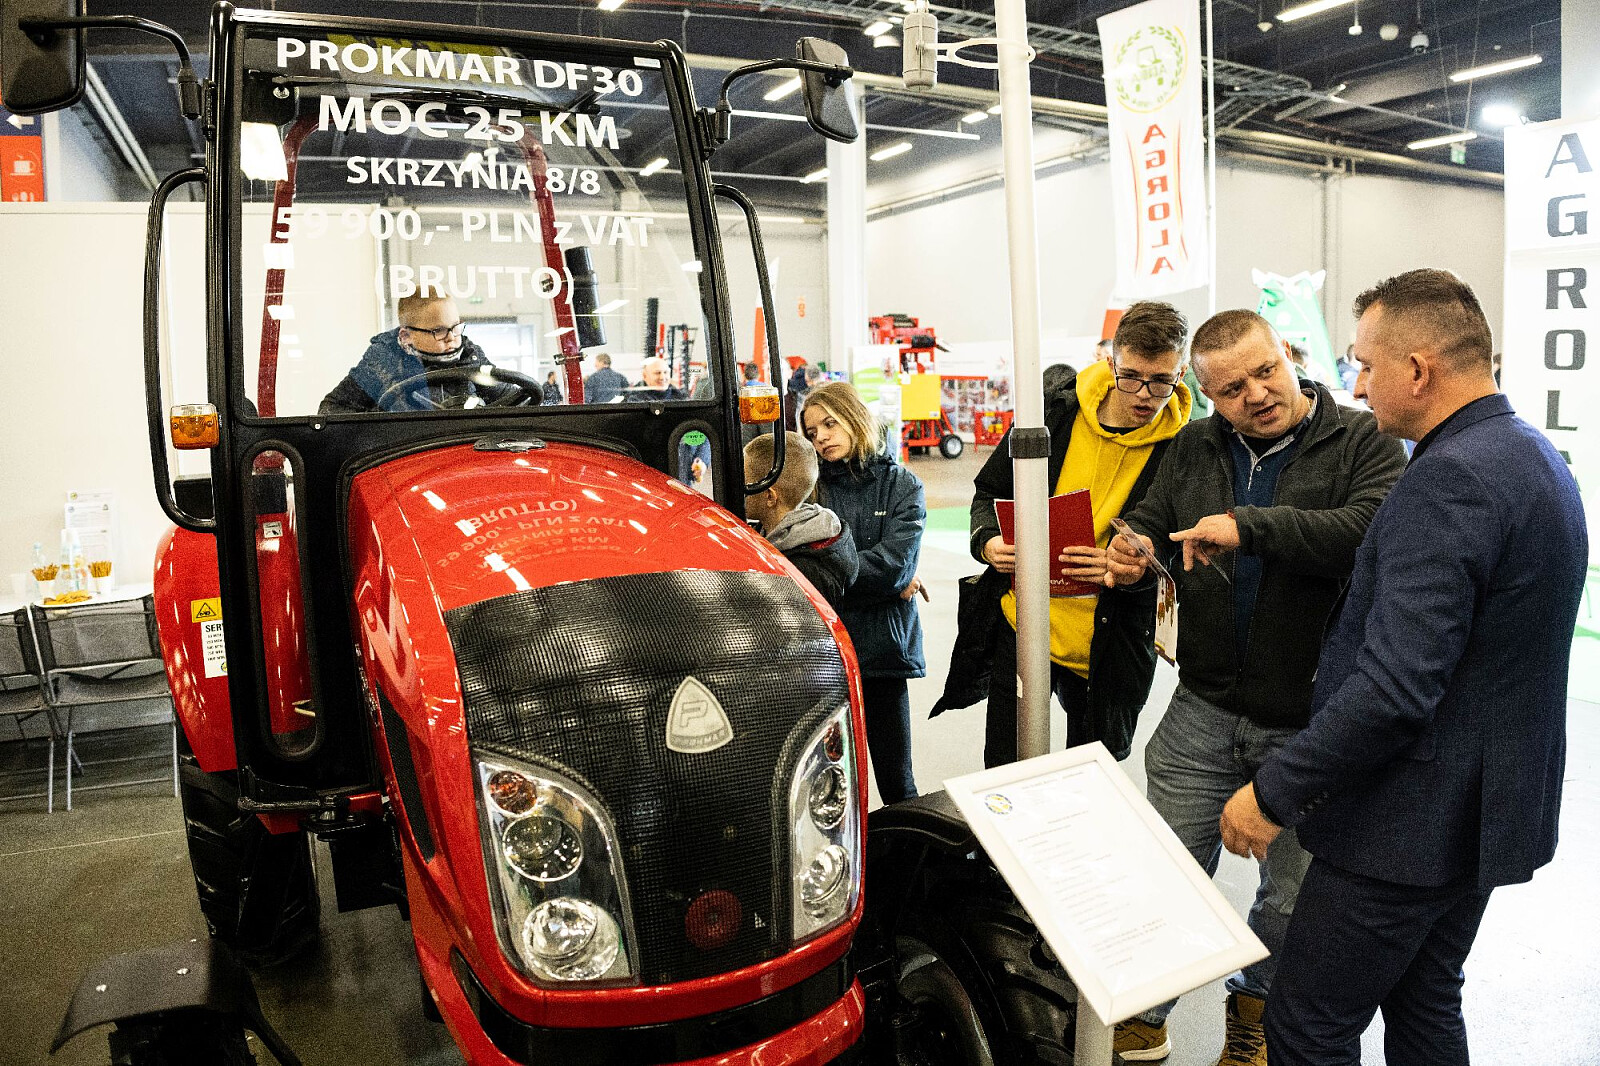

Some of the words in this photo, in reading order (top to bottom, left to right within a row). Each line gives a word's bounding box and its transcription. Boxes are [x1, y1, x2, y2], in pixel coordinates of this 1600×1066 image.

[277, 37, 521, 86] PROKMAR
[533, 59, 643, 97] DF30
[318, 95, 448, 138] MOC
[464, 106, 525, 142] 25
[541, 111, 620, 150] KM
[346, 155, 536, 192] SKRZYNIA
[546, 167, 601, 196] 8/8
[275, 206, 328, 239] 59
[462, 210, 543, 243] PLN
[553, 221, 575, 244] z
[580, 214, 654, 248] VAT
[375, 264, 575, 304] (BRUTTO)
[1544, 132, 1593, 464] AGROL
[205, 623, 224, 633] SER
